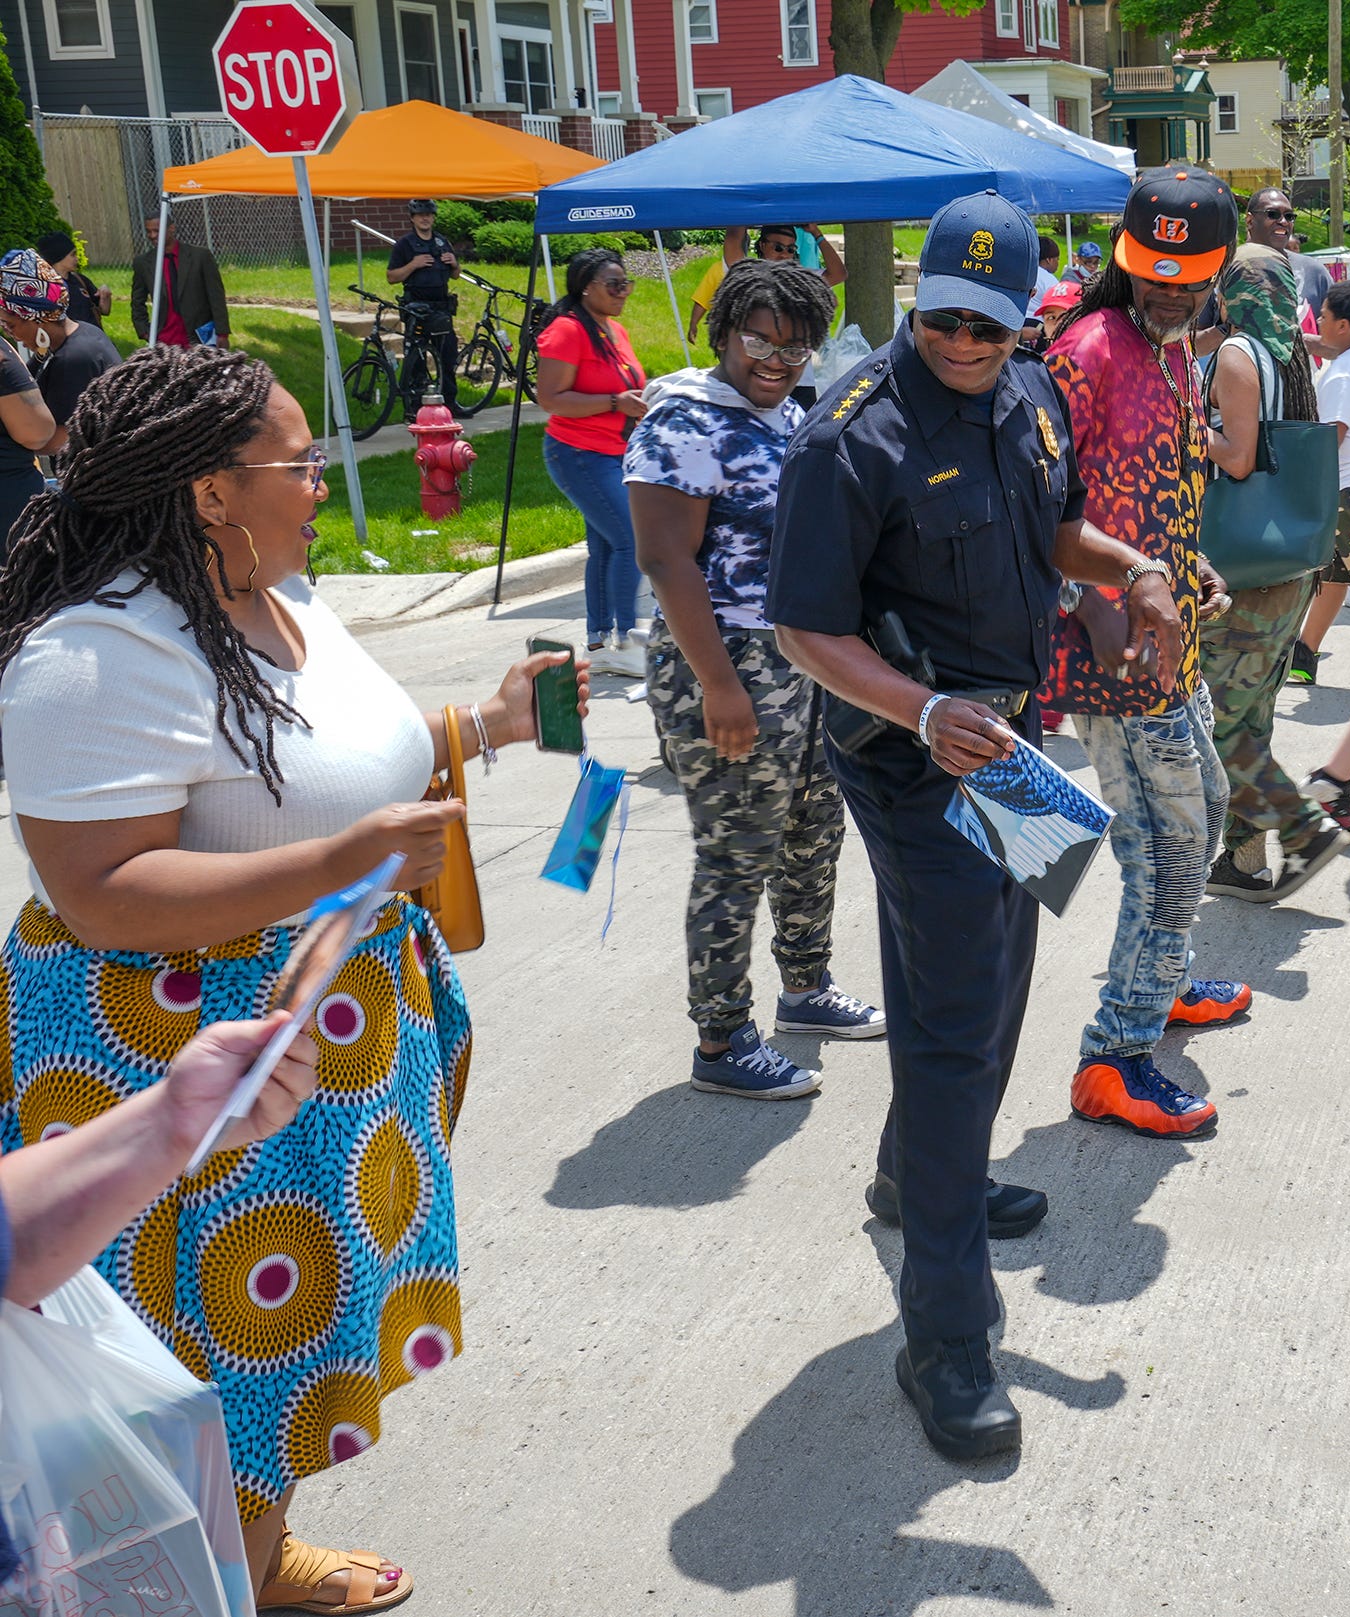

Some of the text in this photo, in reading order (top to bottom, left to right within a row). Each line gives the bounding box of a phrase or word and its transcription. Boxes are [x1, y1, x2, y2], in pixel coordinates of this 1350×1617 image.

[224, 48, 333, 111] STOP
[571, 207, 632, 219] GUIDESMAN
[927, 467, 960, 486] NORMAN
